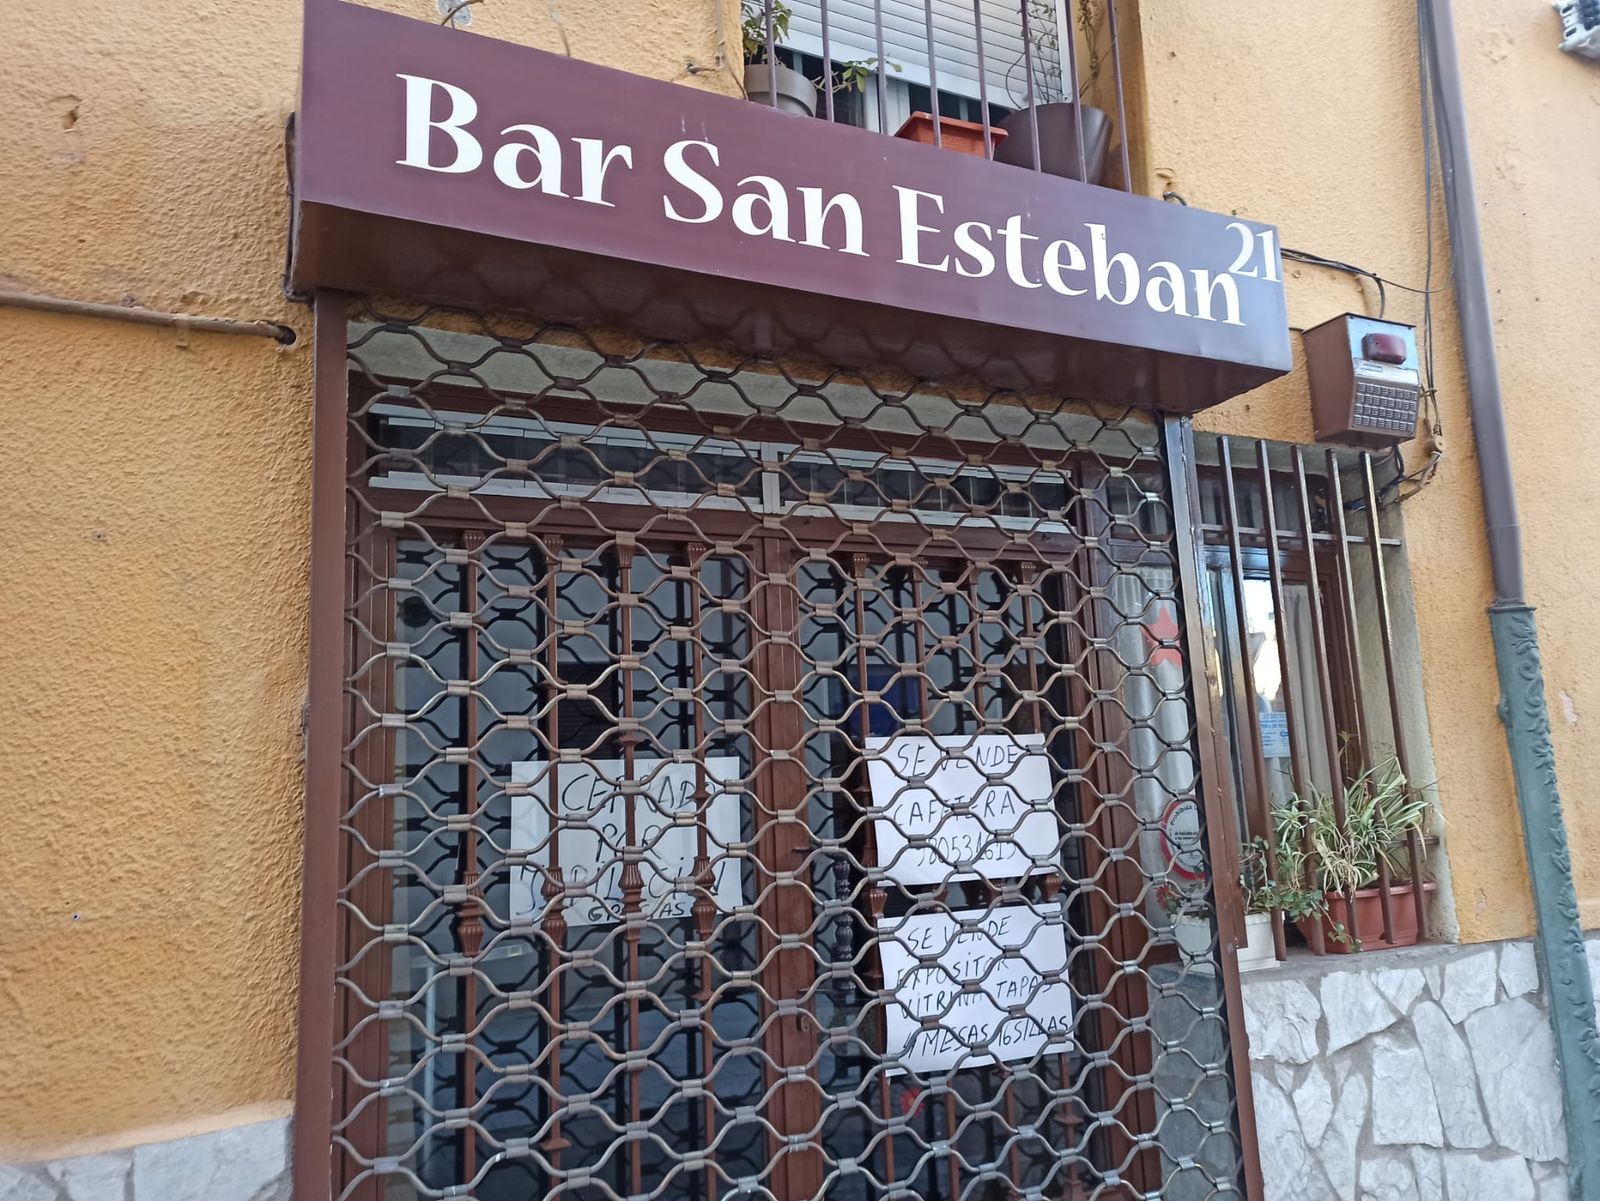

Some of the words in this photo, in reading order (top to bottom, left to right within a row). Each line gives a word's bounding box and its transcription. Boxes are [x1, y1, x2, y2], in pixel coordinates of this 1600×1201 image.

[395, 73, 633, 207] Bar
[662, 139, 871, 257] San
[892, 185, 1246, 327] Esteban
[1225, 221, 1282, 283] 21
[894, 743, 926, 777] SE
[595, 823, 662, 862] POR
[516, 858, 726, 915] JBILCIN
[588, 901, 687, 922] GRAS
[906, 927, 934, 957] SE
[921, 1023, 989, 1057] MESAS
